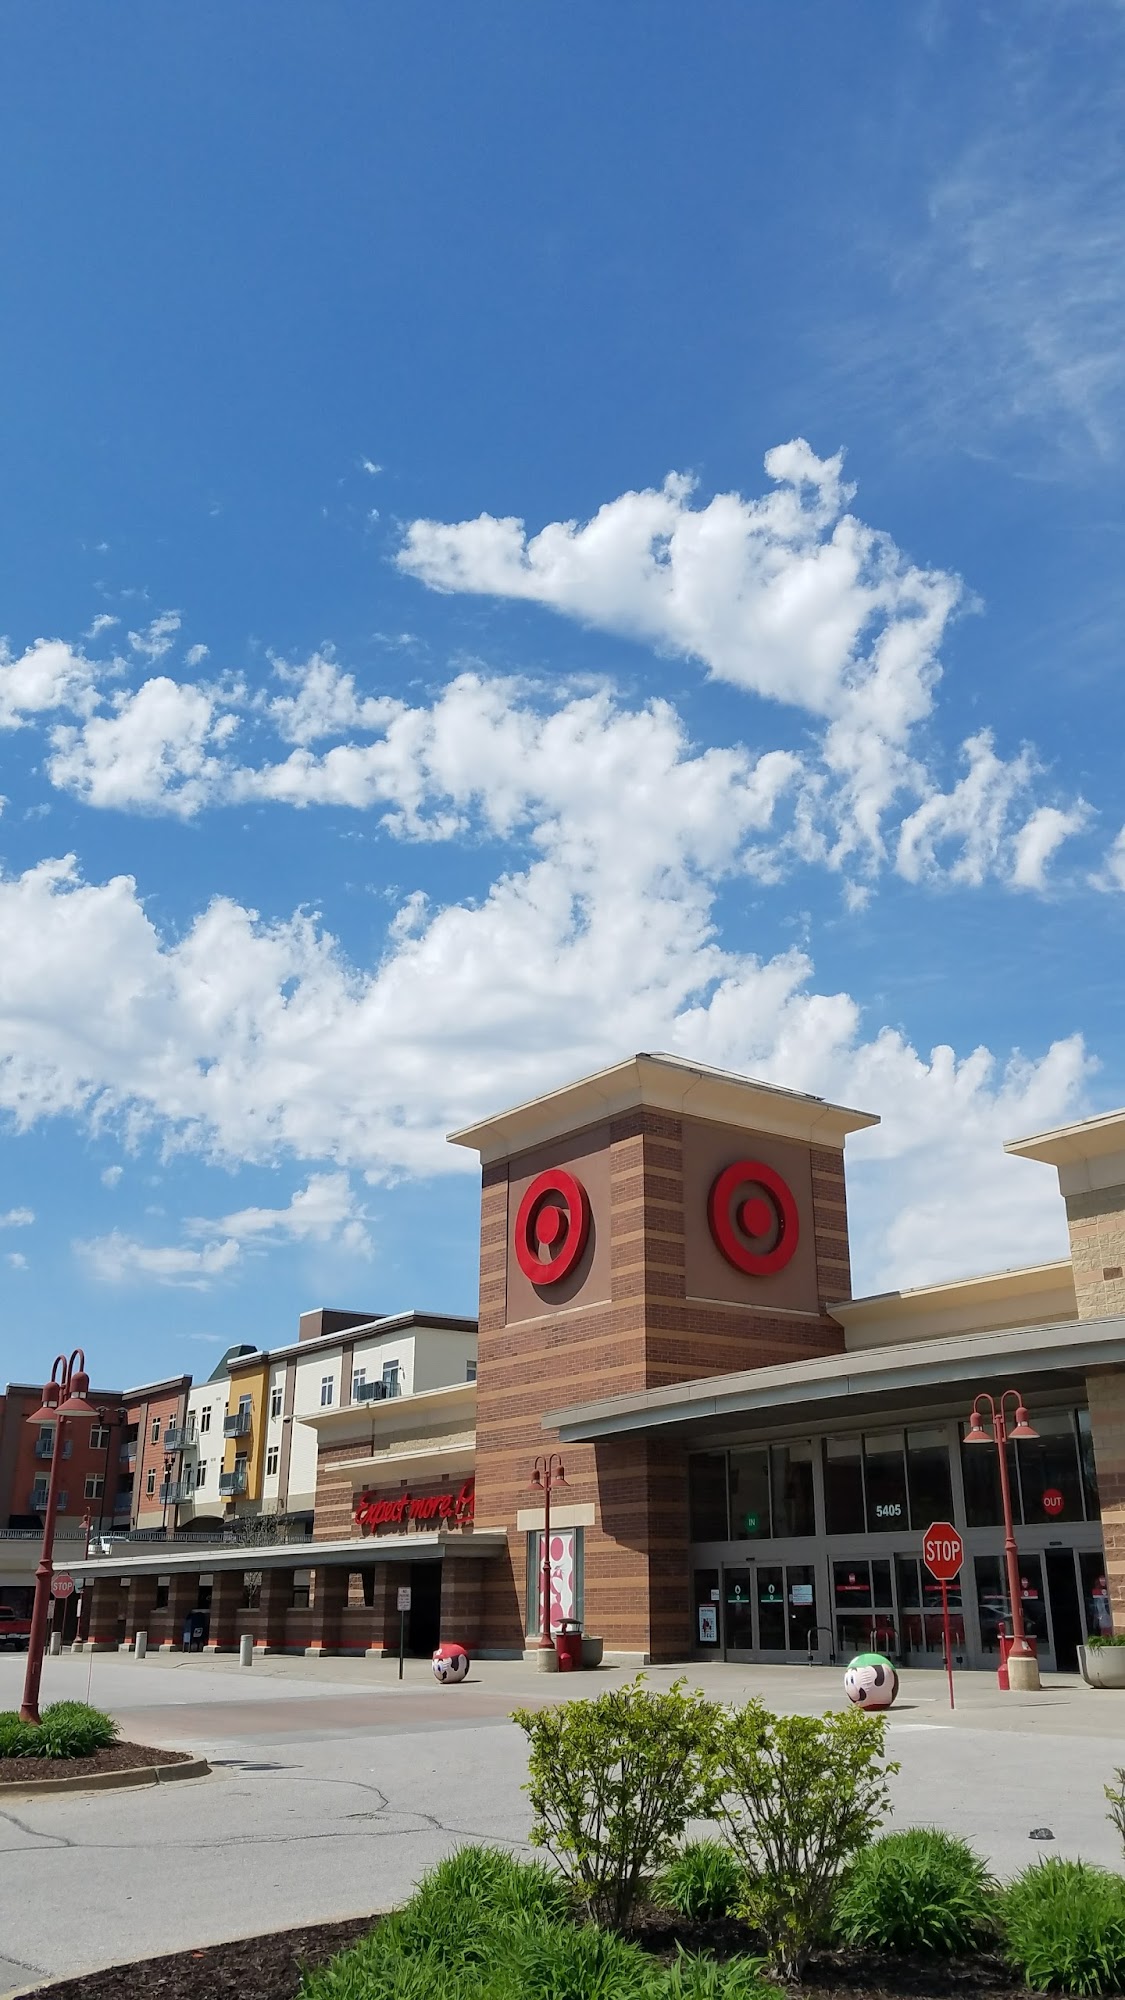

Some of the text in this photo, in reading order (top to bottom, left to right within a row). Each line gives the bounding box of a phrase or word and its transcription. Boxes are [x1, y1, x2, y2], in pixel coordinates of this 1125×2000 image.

[1043, 1497, 1061, 1507] OUT
[355, 1490, 410, 1533] Expect
[409, 1495, 454, 1519] more.
[876, 1504, 902, 1517] 5405
[748, 1518, 756, 1526] IN
[926, 1541, 960, 1561] STOP
[53, 1582, 73, 1590] STOP
